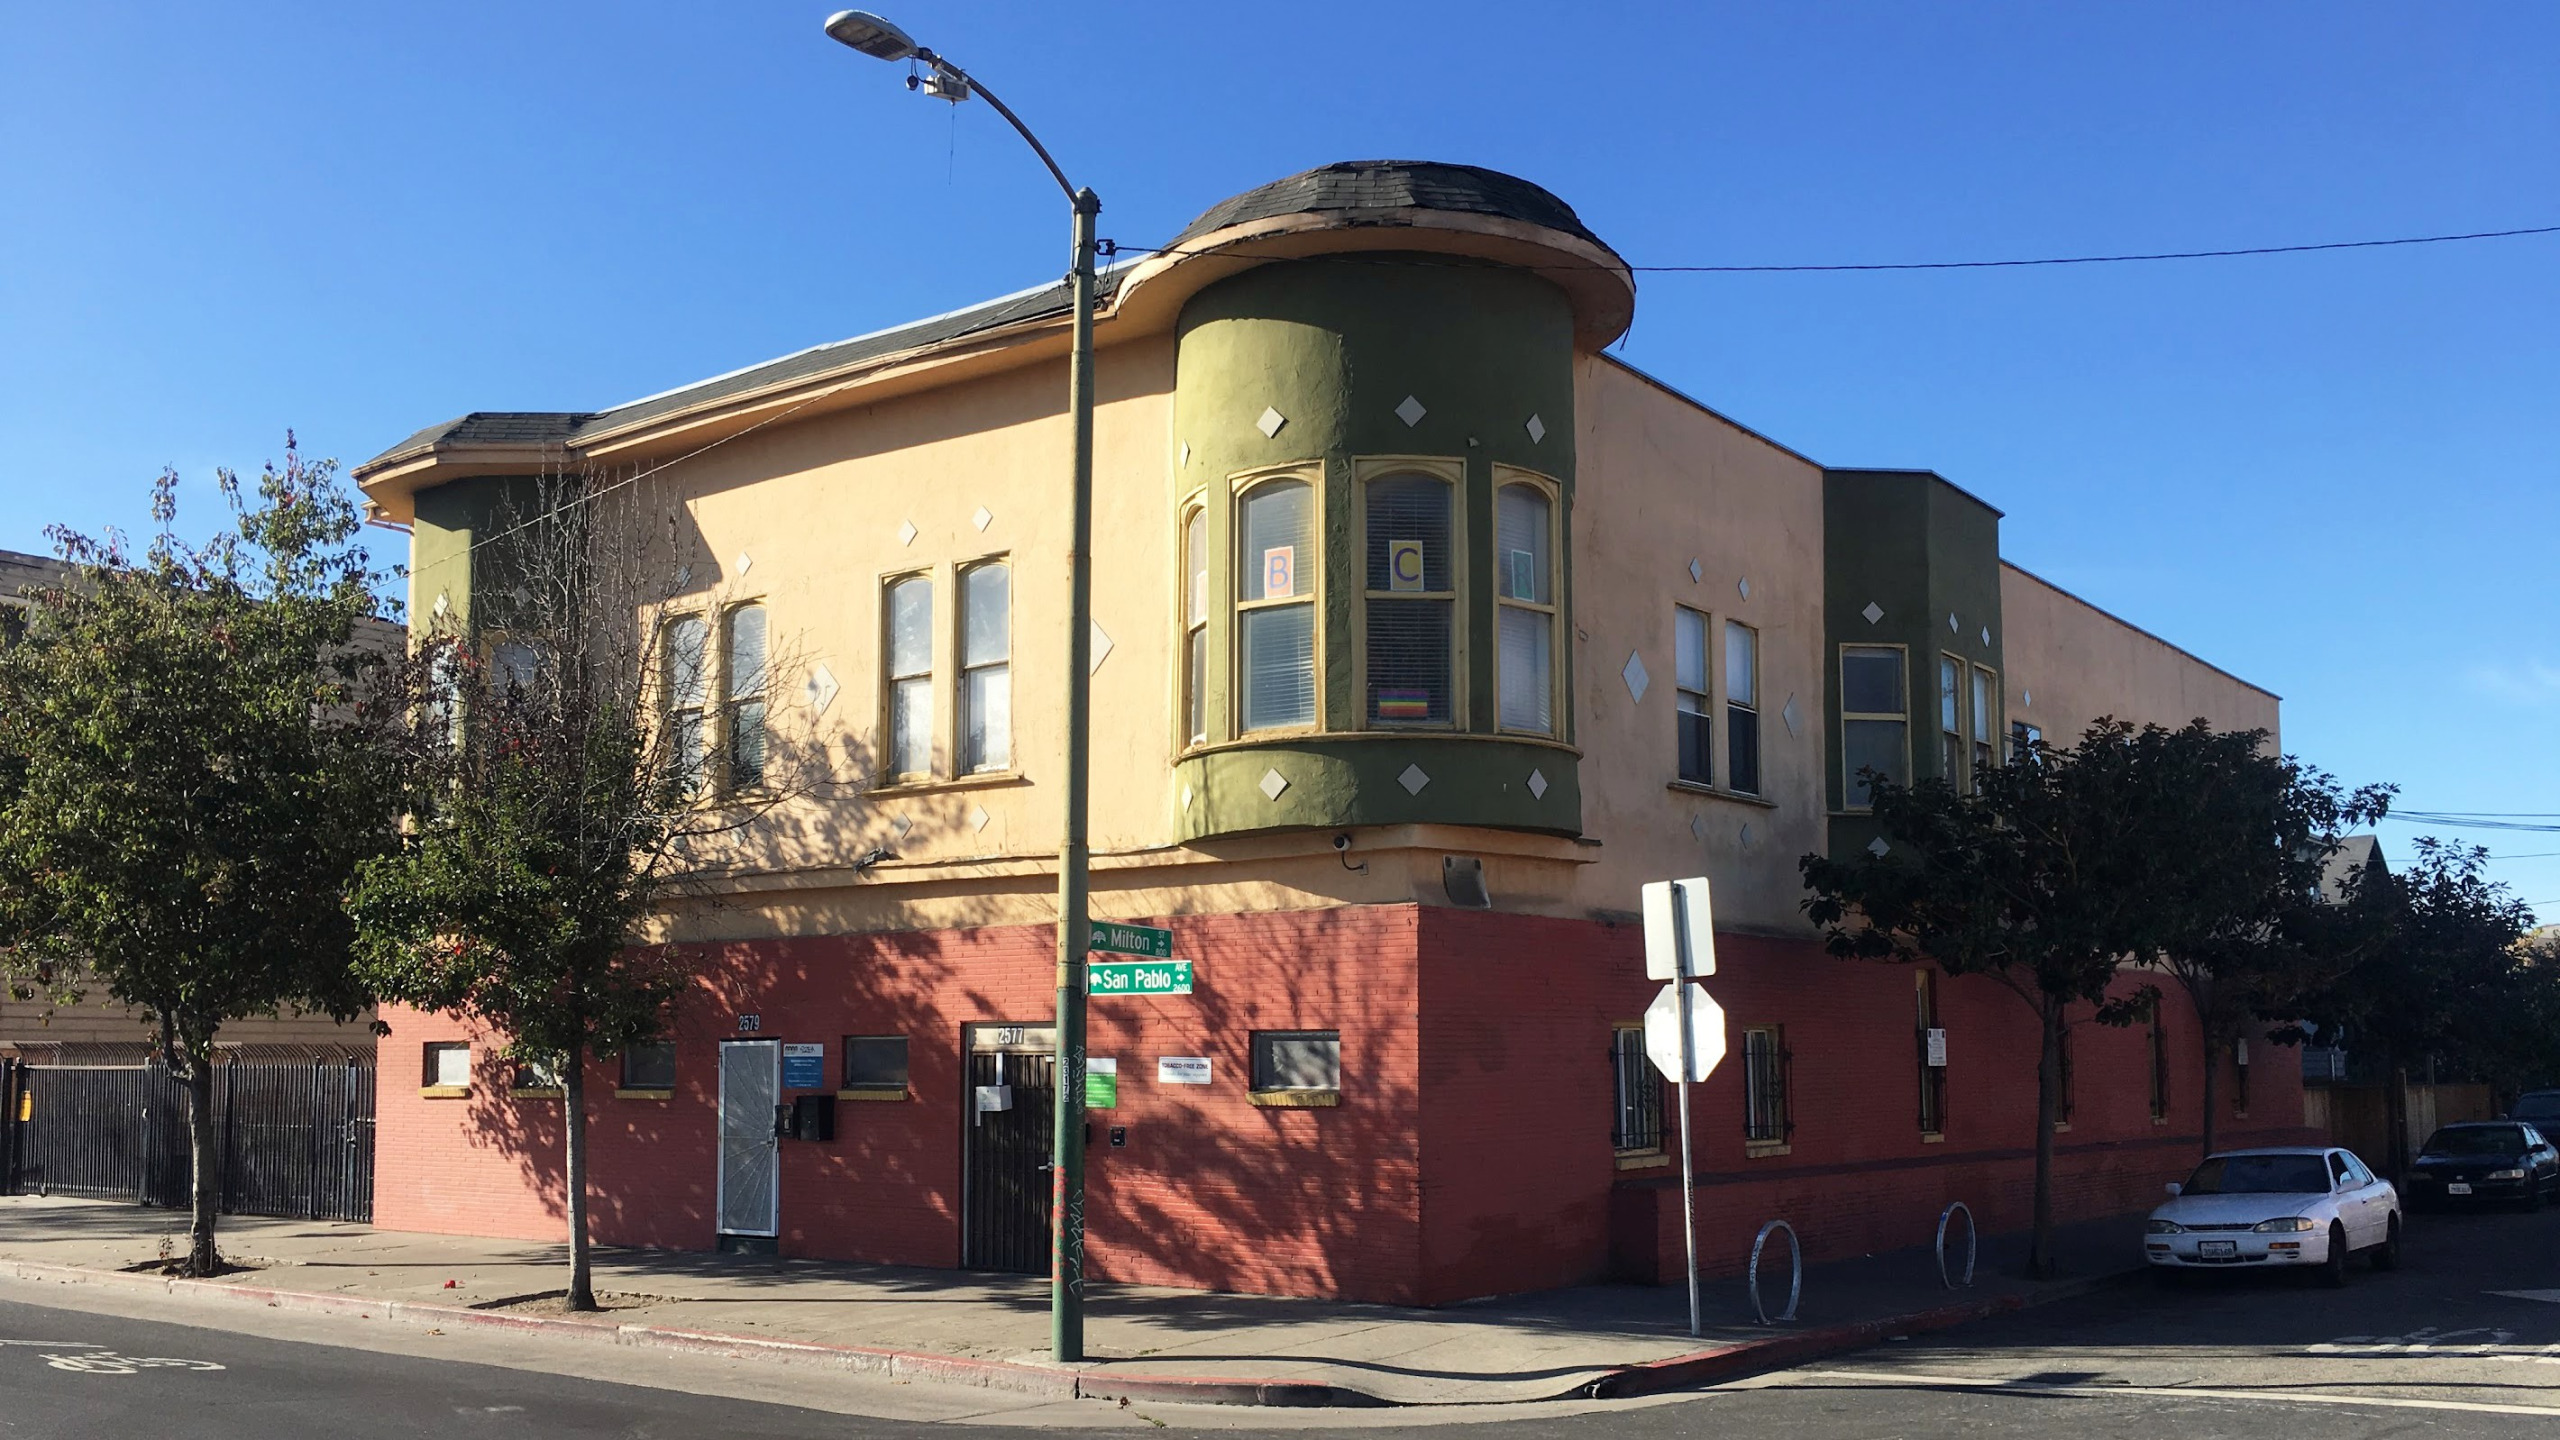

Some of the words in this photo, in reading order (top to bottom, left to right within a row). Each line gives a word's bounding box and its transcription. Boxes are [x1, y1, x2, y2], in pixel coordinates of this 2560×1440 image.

[1269, 555, 1289, 589] B
[1394, 547, 1420, 582] C
[1110, 928, 1150, 951] Milton
[1158, 931, 1165, 939] ST
[1175, 963, 1188, 972] AVE
[1103, 969, 1129, 989] San
[1135, 968, 1172, 989] Pablo
[1173, 983, 1191, 993] 2600
[739, 1014, 760, 1031] 2579
[998, 1027, 1024, 1044] 2577
